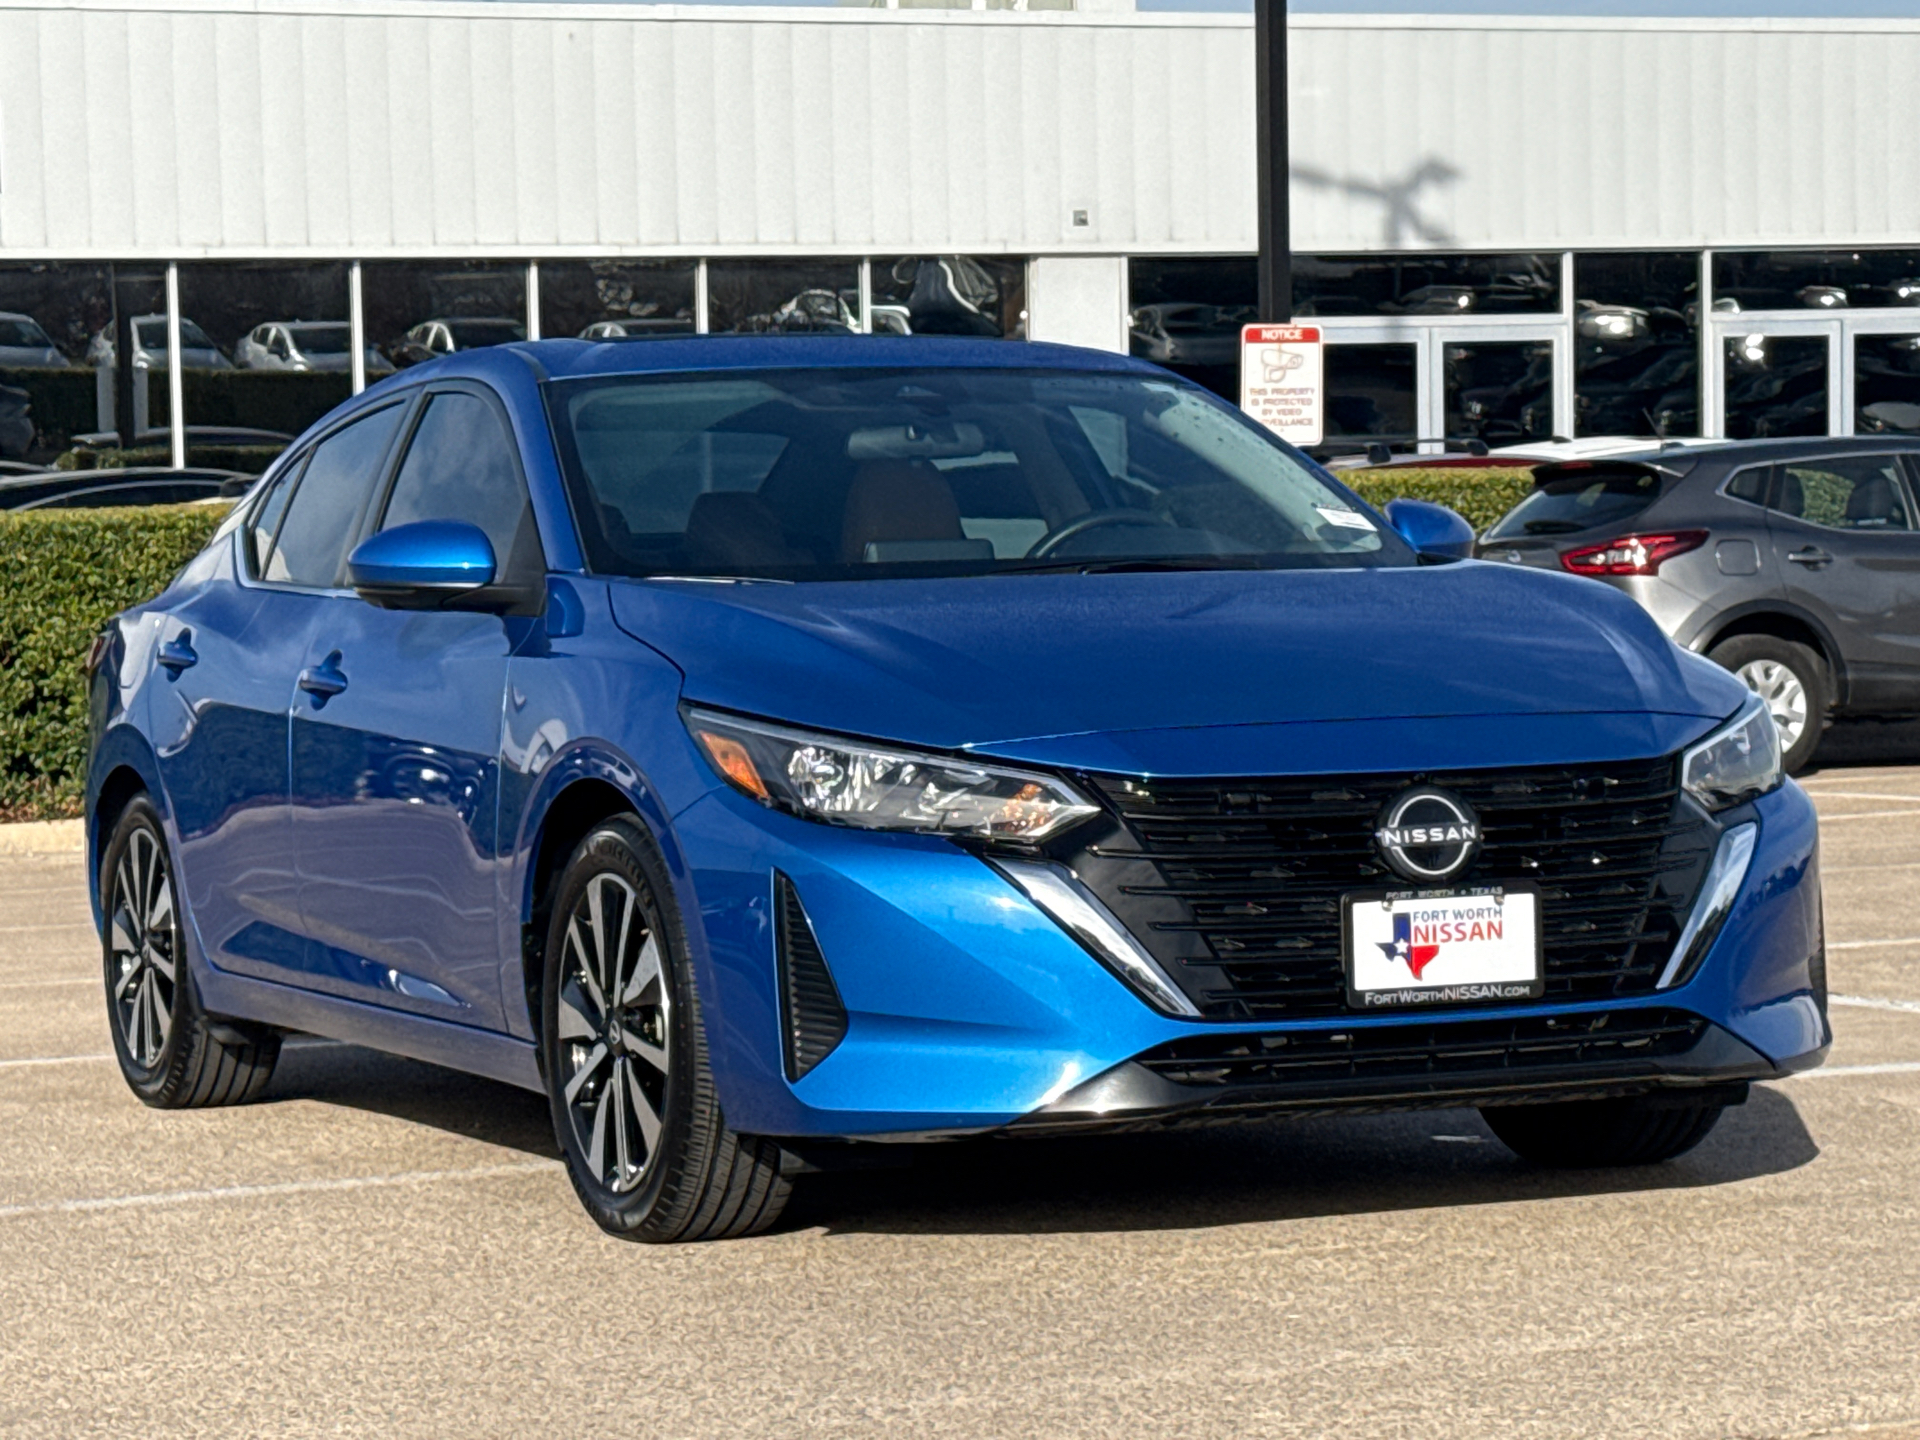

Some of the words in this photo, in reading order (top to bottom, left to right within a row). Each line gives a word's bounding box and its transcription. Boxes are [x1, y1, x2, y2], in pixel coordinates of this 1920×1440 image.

[1261, 329, 1303, 340] NOTICE
[1249, 387, 1268, 396] THIS
[1271, 387, 1315, 396] PROPERTY
[1263, 398, 1313, 406] PROTECTED
[1262, 408, 1273, 416] BY
[1276, 408, 1303, 416] VIDEO
[1384, 825, 1476, 844] NISSAN
[1385, 890, 1414, 900] FORT
[1417, 888, 1455, 898] WORTH
[1470, 886, 1504, 896] TEXAS
[1413, 909, 1449, 923] FORT
[1452, 907, 1503, 920] WORTH
[1413, 920, 1503, 944] NISSAN
